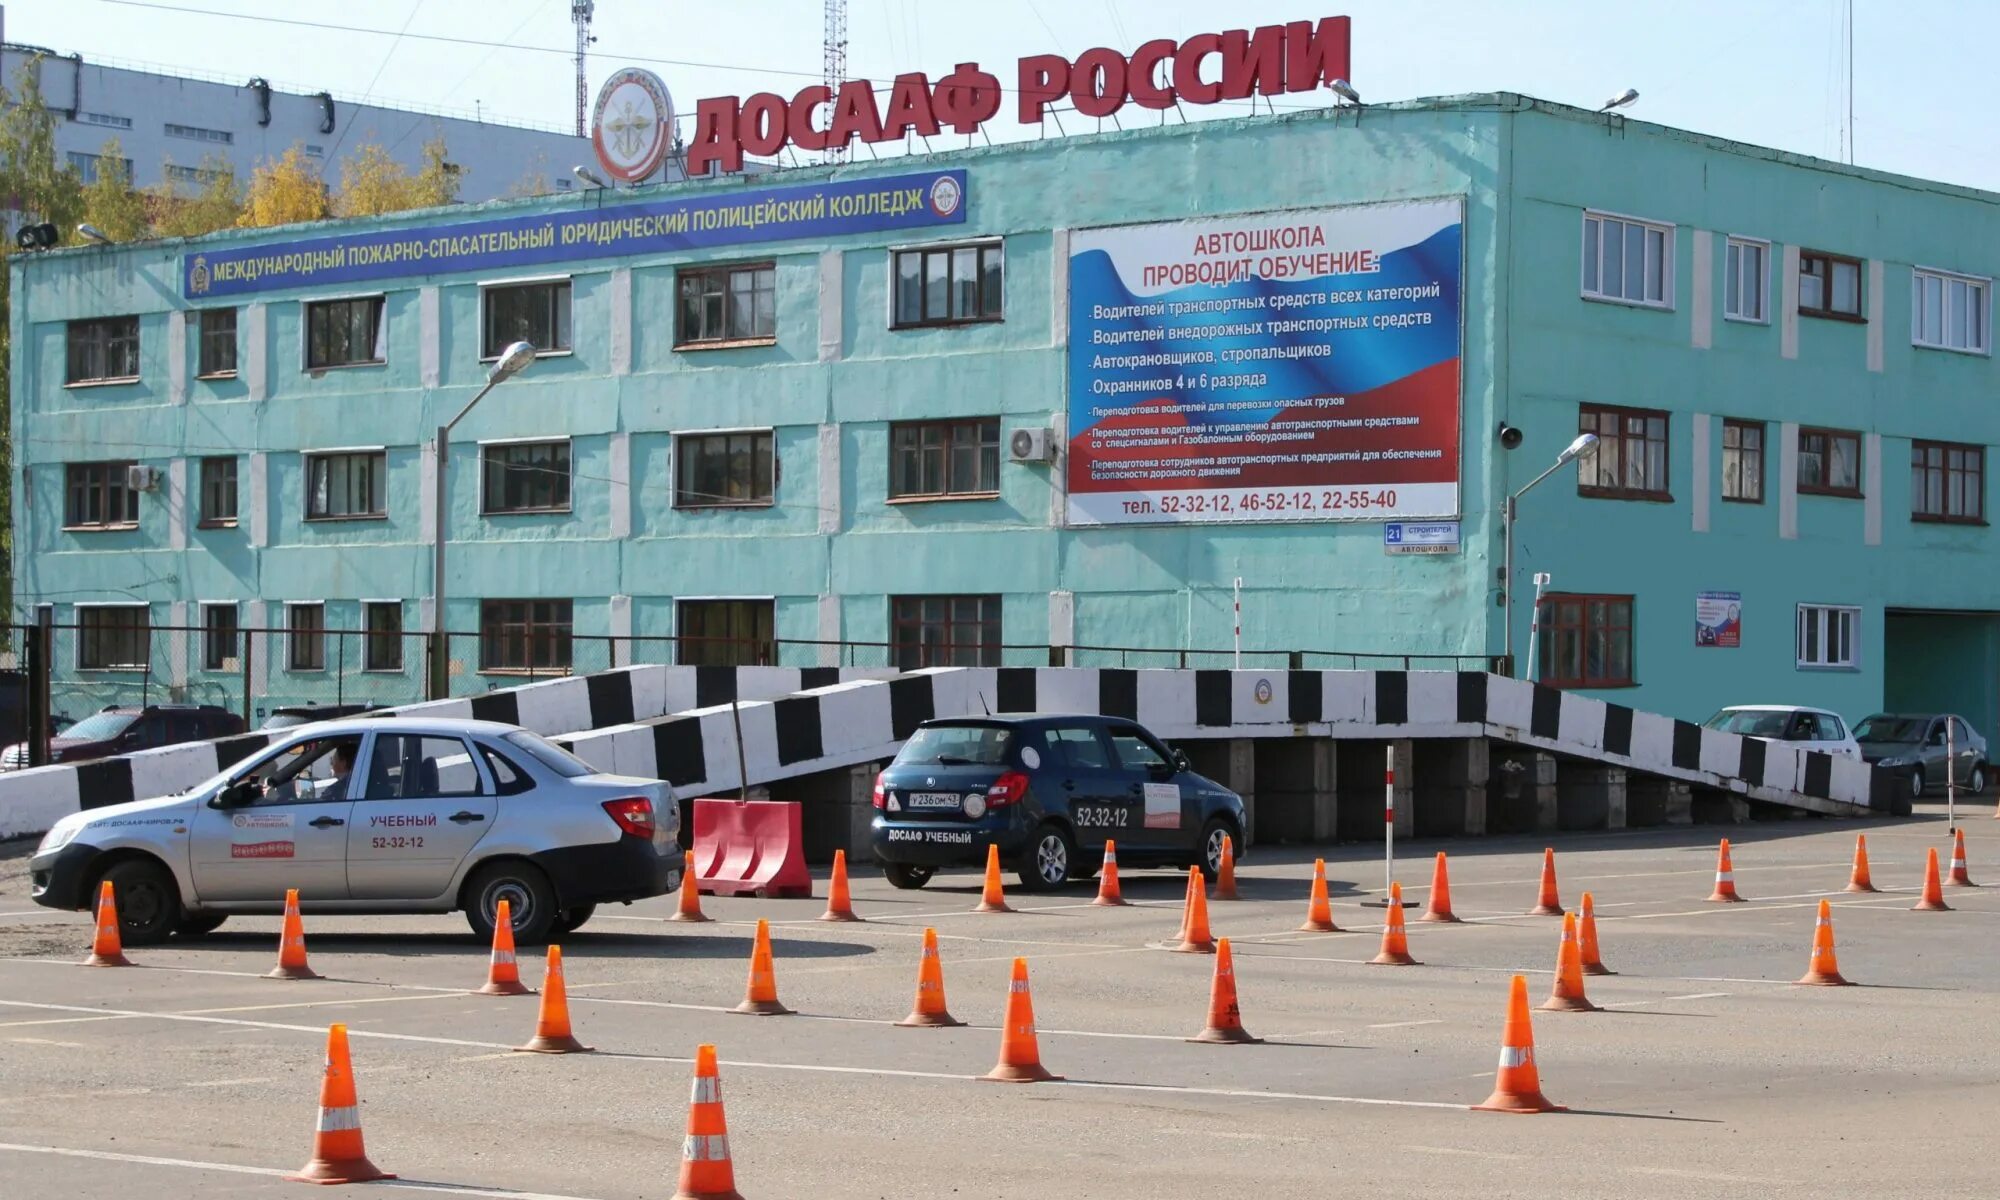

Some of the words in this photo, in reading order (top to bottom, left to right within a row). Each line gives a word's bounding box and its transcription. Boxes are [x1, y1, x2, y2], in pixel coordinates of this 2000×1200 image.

[687, 61, 1001, 175] ДОСААФ
[1018, 15, 1350, 124] РОССИИ
[214, 245, 346, 282] МЕЖДУНАРОДНЫЙ
[349, 223, 554, 265] ПОЖАРНО-СПАСАТЕЛЬНЫЙ
[560, 208, 689, 245] ЮРИДИЧЕСКИЙ
[693, 195, 825, 230] ПОЛИЦЕЙСКИЙ
[830, 188, 924, 219] КОЛЛЕДЖ
[1194, 226, 1325, 256] АВТОШКОЛА
[1143, 259, 1253, 286] ПРОВОДИТ
[1259, 250, 1380, 278] ОБУЧЕНИЕ:
[1093, 300, 1165, 320] Водителей
[1169, 296, 1265, 316] транспортных
[1269, 292, 1326, 310] средств
[1330, 290, 1362, 304] всех
[1366, 281, 1440, 303] категорий
[1093, 325, 1165, 345] Водителей
[1169, 321, 1263, 341] внедорожных
[1266, 315, 1368, 335] транспортных
[1372, 311, 1432, 329] средств
[1093, 350, 1218, 370] Автокрановщиков,
[1221, 344, 1331, 364] стропальщиков
[1093, 377, 1173, 396] Охранников
[1176, 377, 1184, 390] 4
[1188, 378, 1196, 389] и
[1200, 374, 1208, 388] 6
[1211, 372, 1266, 390] разряда
[1092, 405, 1159, 417] Переподготовка
[1161, 402, 1206, 415] водителей
[1208, 402, 1225, 412] для
[1227, 400, 1271, 411] перевозки
[1274, 398, 1312, 408] опасных
[1315, 397, 1344, 408] грузов
[1092, 427, 1159, 439] Переподготовка
[1161, 423, 1206, 436] водителей
[1208, 425, 1213, 433] к
[1214, 423, 1268, 434] управлению
[1271, 417, 1362, 430] автотранспортными
[1365, 415, 1419, 428] средствами
[1106, 437, 1169, 449] спецсигналами
[1171, 437, 1177, 445] и
[1179, 434, 1242, 445] Газобалонным
[1245, 431, 1314, 445] оборудованием
[1160, 456, 1214, 469] сотрудников
[1217, 453, 1298, 465] автотранспортных
[1301, 450, 1360, 463] предприятий
[1362, 452, 1379, 461] для
[1382, 448, 1441, 460] обеспечения
[1091, 470, 1147, 480] безопасности
[1150, 468, 1196, 480] дорожного
[1198, 467, 1240, 478] движения
[1122, 501, 1155, 514] тел.
[1161, 495, 1234, 514] 52-32-12,
[1240, 492, 1316, 512] 46-52-12,
[1322, 490, 1397, 509] 22-55-40
[1388, 529, 1400, 539] 21
[1408, 525, 1452, 534] СТРОИТЕЛЕЙ
[370, 812, 437, 827] УЧЕБНЫЙ
[1077, 807, 1127, 827] 52-32-12
[372, 836, 424, 848] 52-32-12
[889, 829, 922, 842] ДОСААФ
[925, 831, 972, 844] УЧЕБНЫЙ
